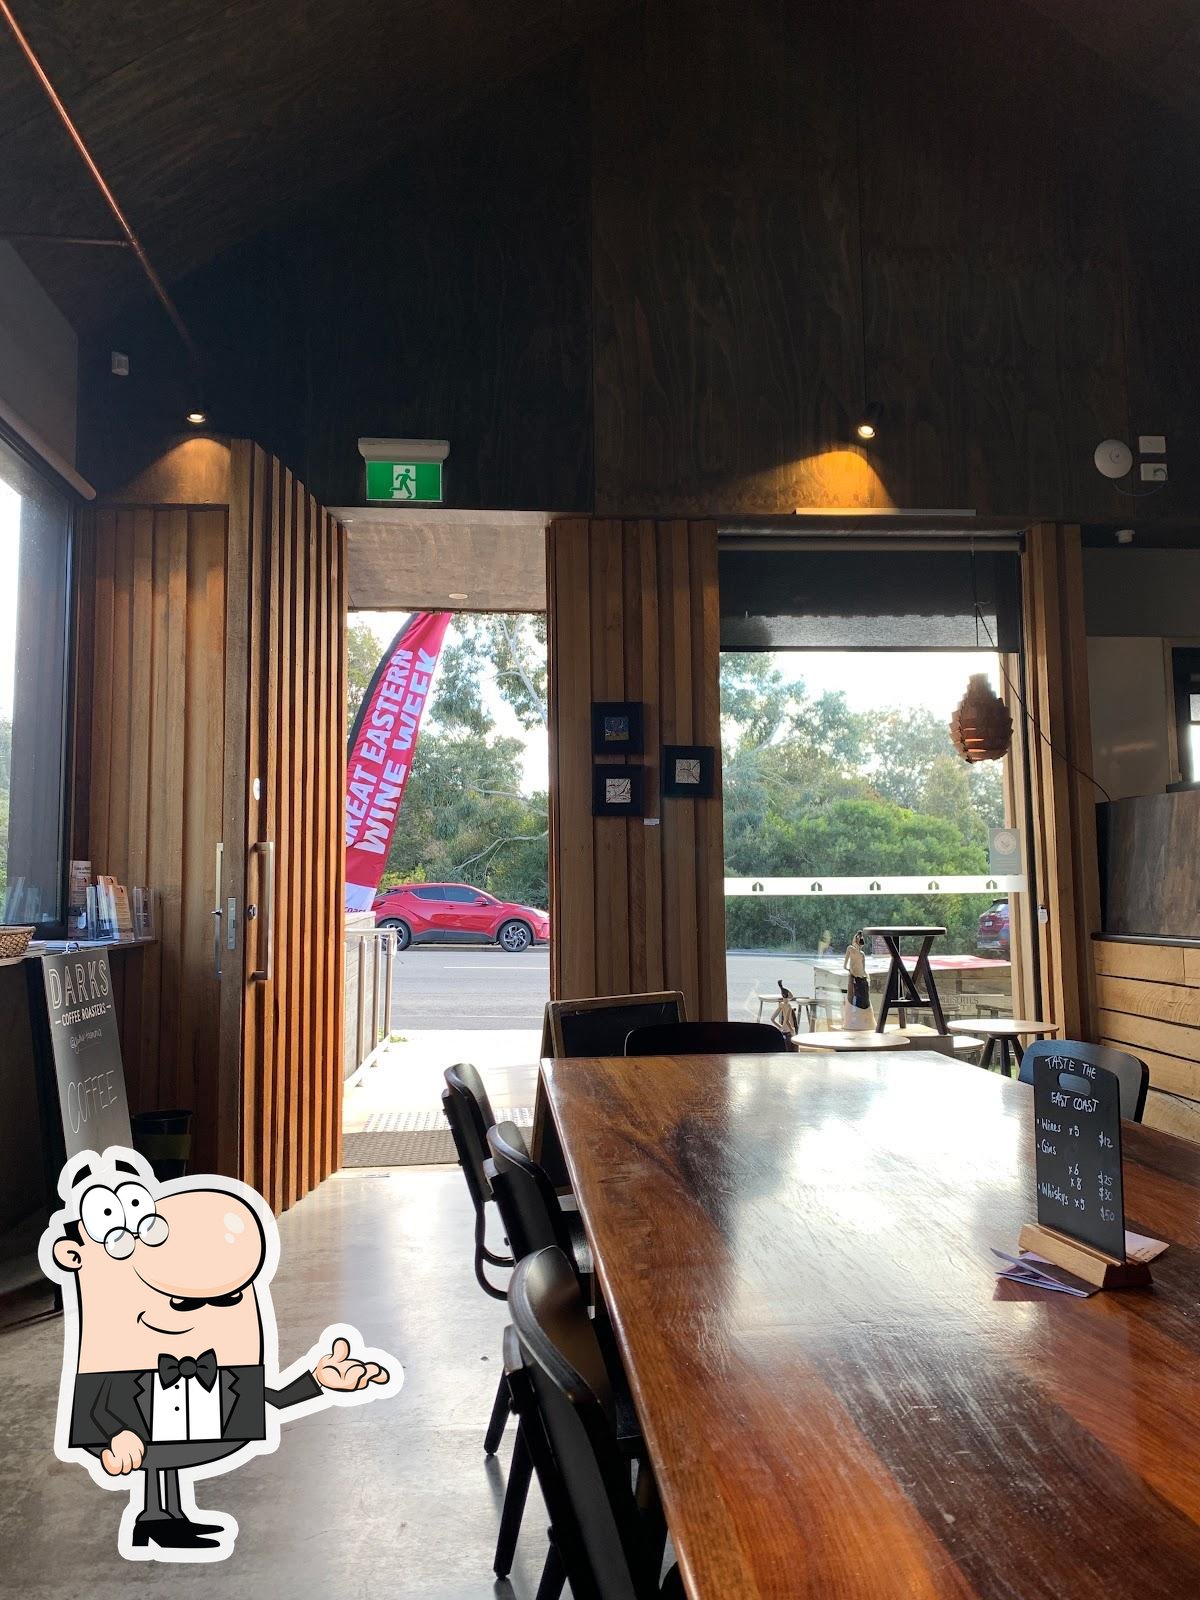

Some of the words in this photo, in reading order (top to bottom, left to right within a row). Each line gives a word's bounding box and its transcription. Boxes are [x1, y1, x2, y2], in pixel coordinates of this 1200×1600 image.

[360, 649, 413, 764] EASTERN
[353, 760, 407, 854] WINE
[392, 648, 437, 750] WEEK
[49, 960, 108, 1009] DARKS
[62, 1010, 81, 1026] COFFEE
[82, 1003, 106, 1020] ROASTERS
[1045, 1056, 1075, 1071] TASTE
[1082, 1063, 1096, 1079] THE
[68, 1070, 117, 1133] COFFEE
[1051, 1092, 1071, 1107] EAST
[1073, 1098, 1099, 1112] COAST
[1042, 1139, 1056, 1155] Gins
[1099, 1131, 1113, 1148] $12
